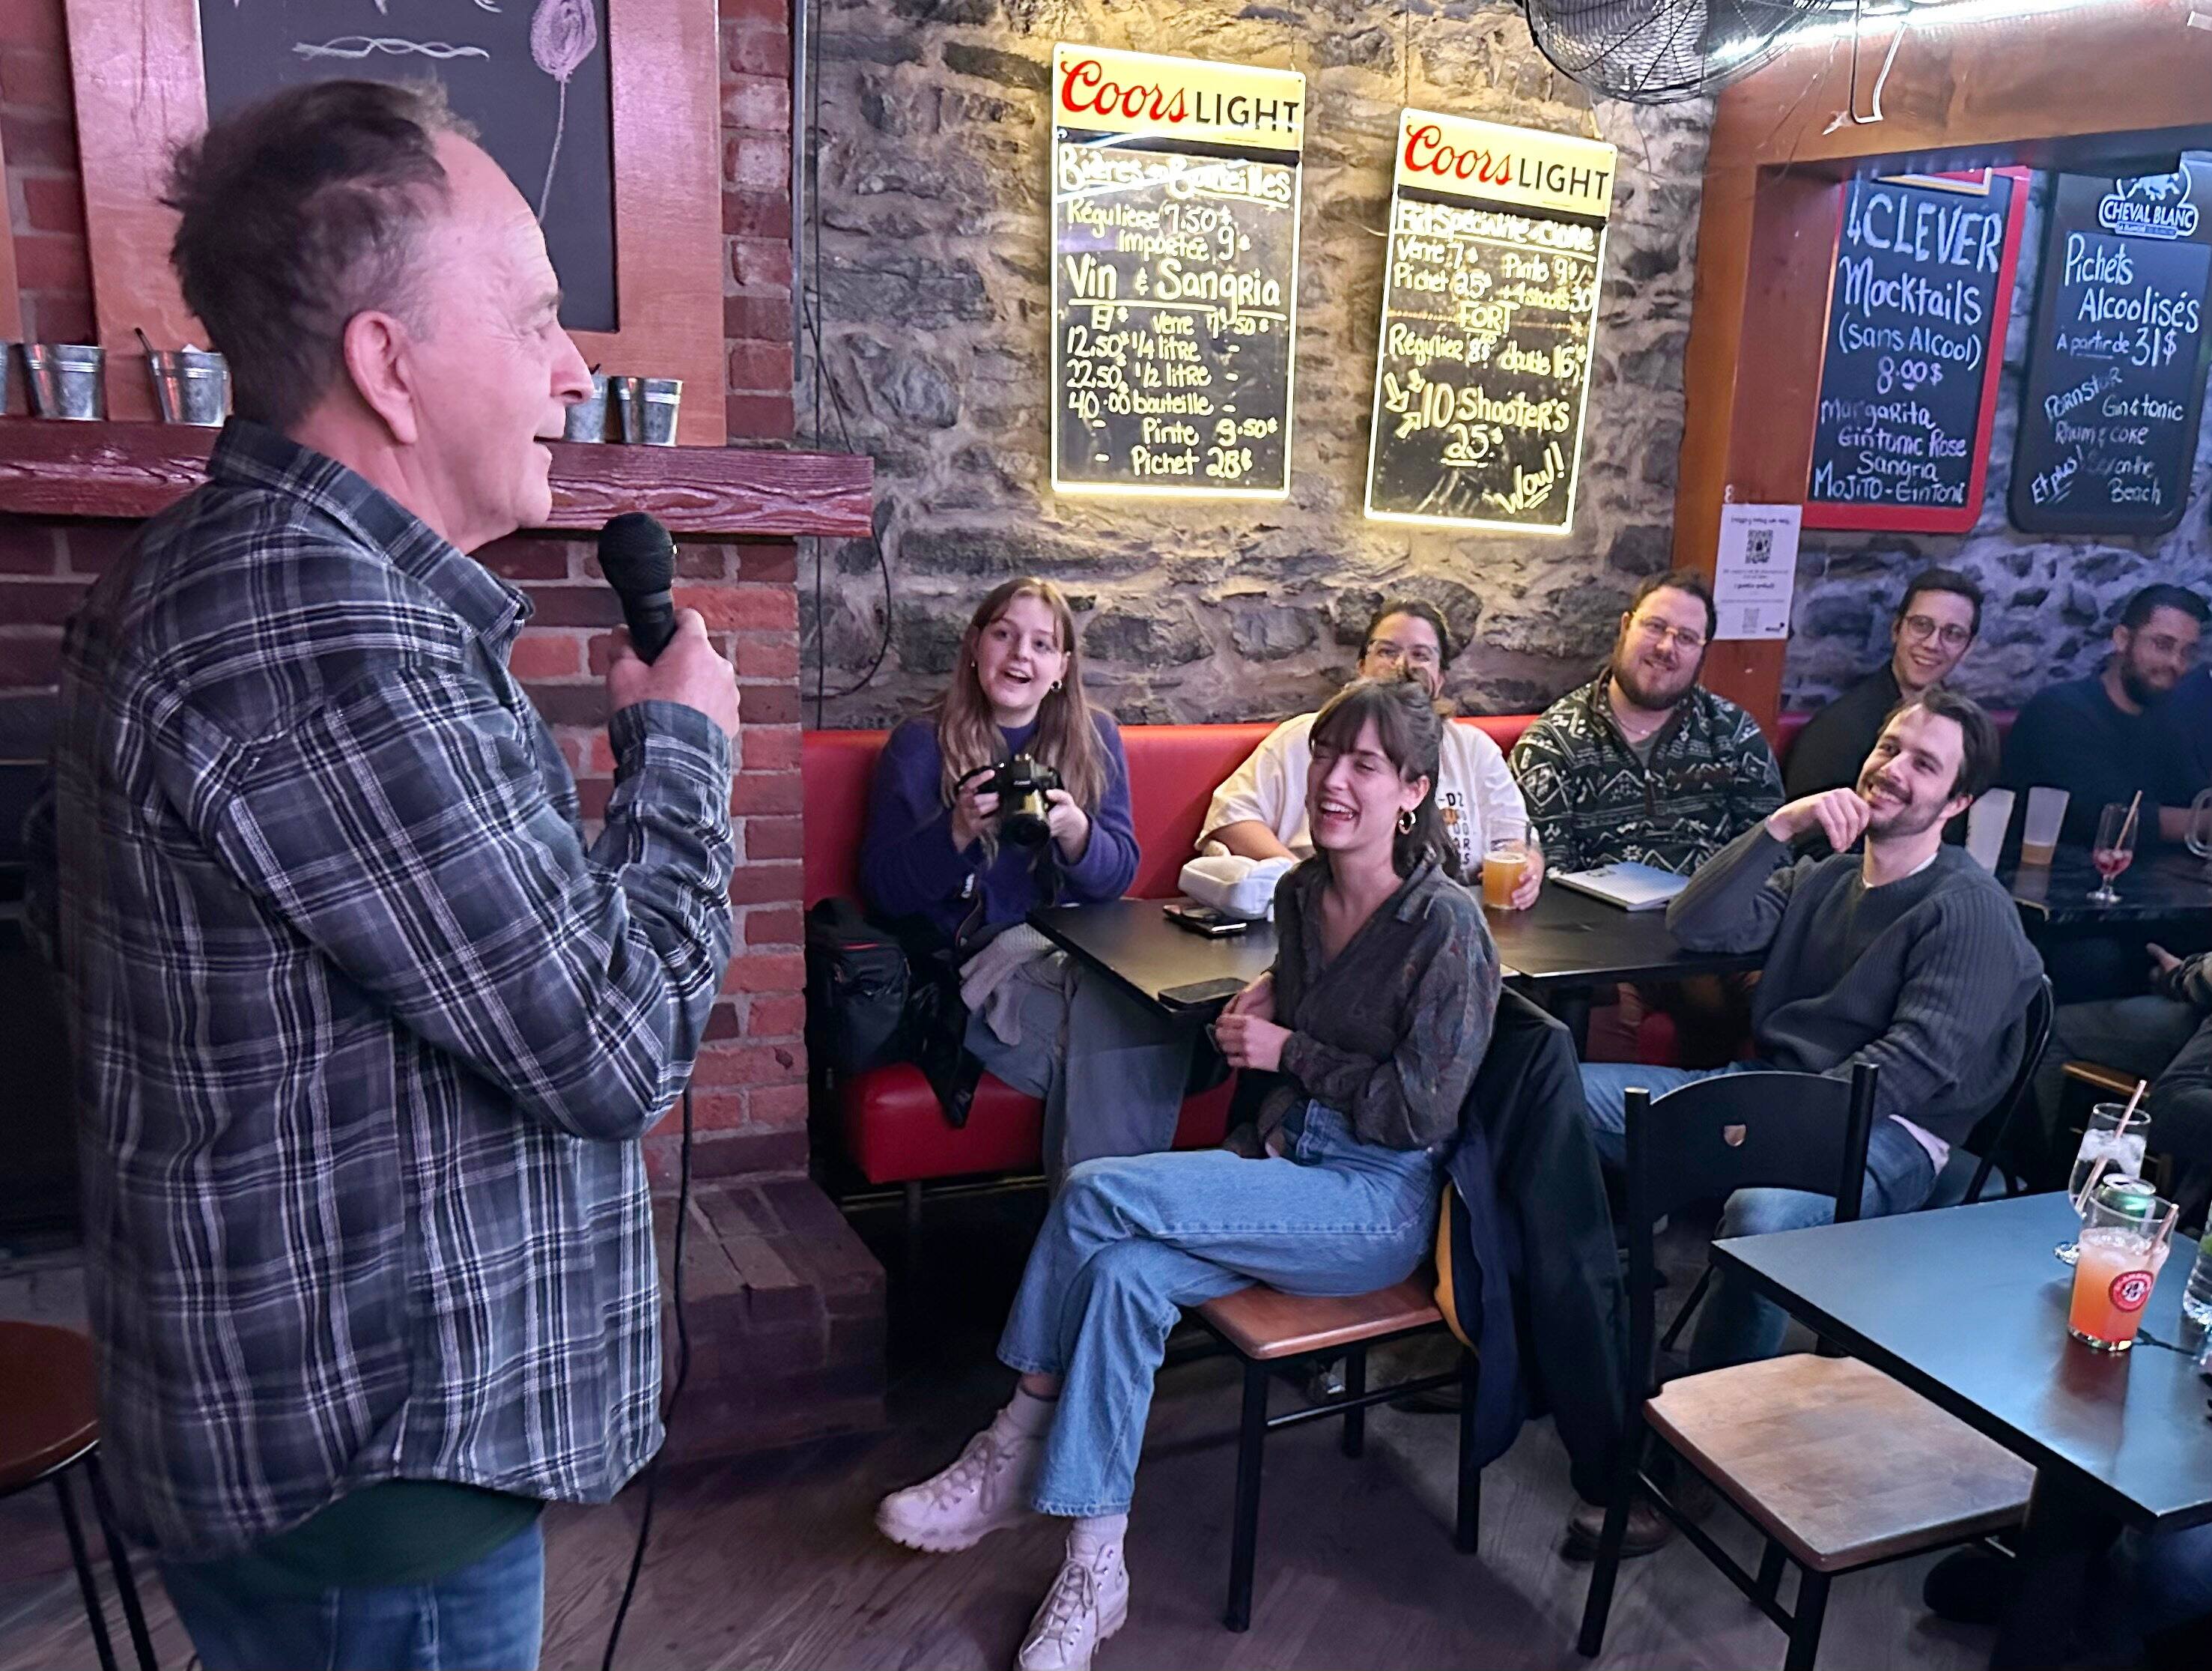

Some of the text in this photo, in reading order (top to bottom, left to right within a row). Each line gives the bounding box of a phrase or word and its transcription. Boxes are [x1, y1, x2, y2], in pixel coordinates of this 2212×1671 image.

[1060, 61, 1299, 133] Coors LIGHT
[1405, 124, 1608, 200] Coors LIGHT
[2104, 201, 2195, 228] CHEVAL BLANC
[2064, 234, 2133, 286] Pichets
[1066, 255, 1116, 299] Vin
[1460, 300, 1520, 333] FORT
[2078, 286, 2200, 333] Alcoolisés
[2070, 330, 2112, 357] partir
[2112, 332, 2130, 354] de
[1422, 383, 1455, 428] 10
[2142, 394, 2184, 421] tonic
[1143, 417, 1200, 446] Pinte
[1131, 445, 1200, 476] Pichet
[2107, 476, 2161, 506] Beach
